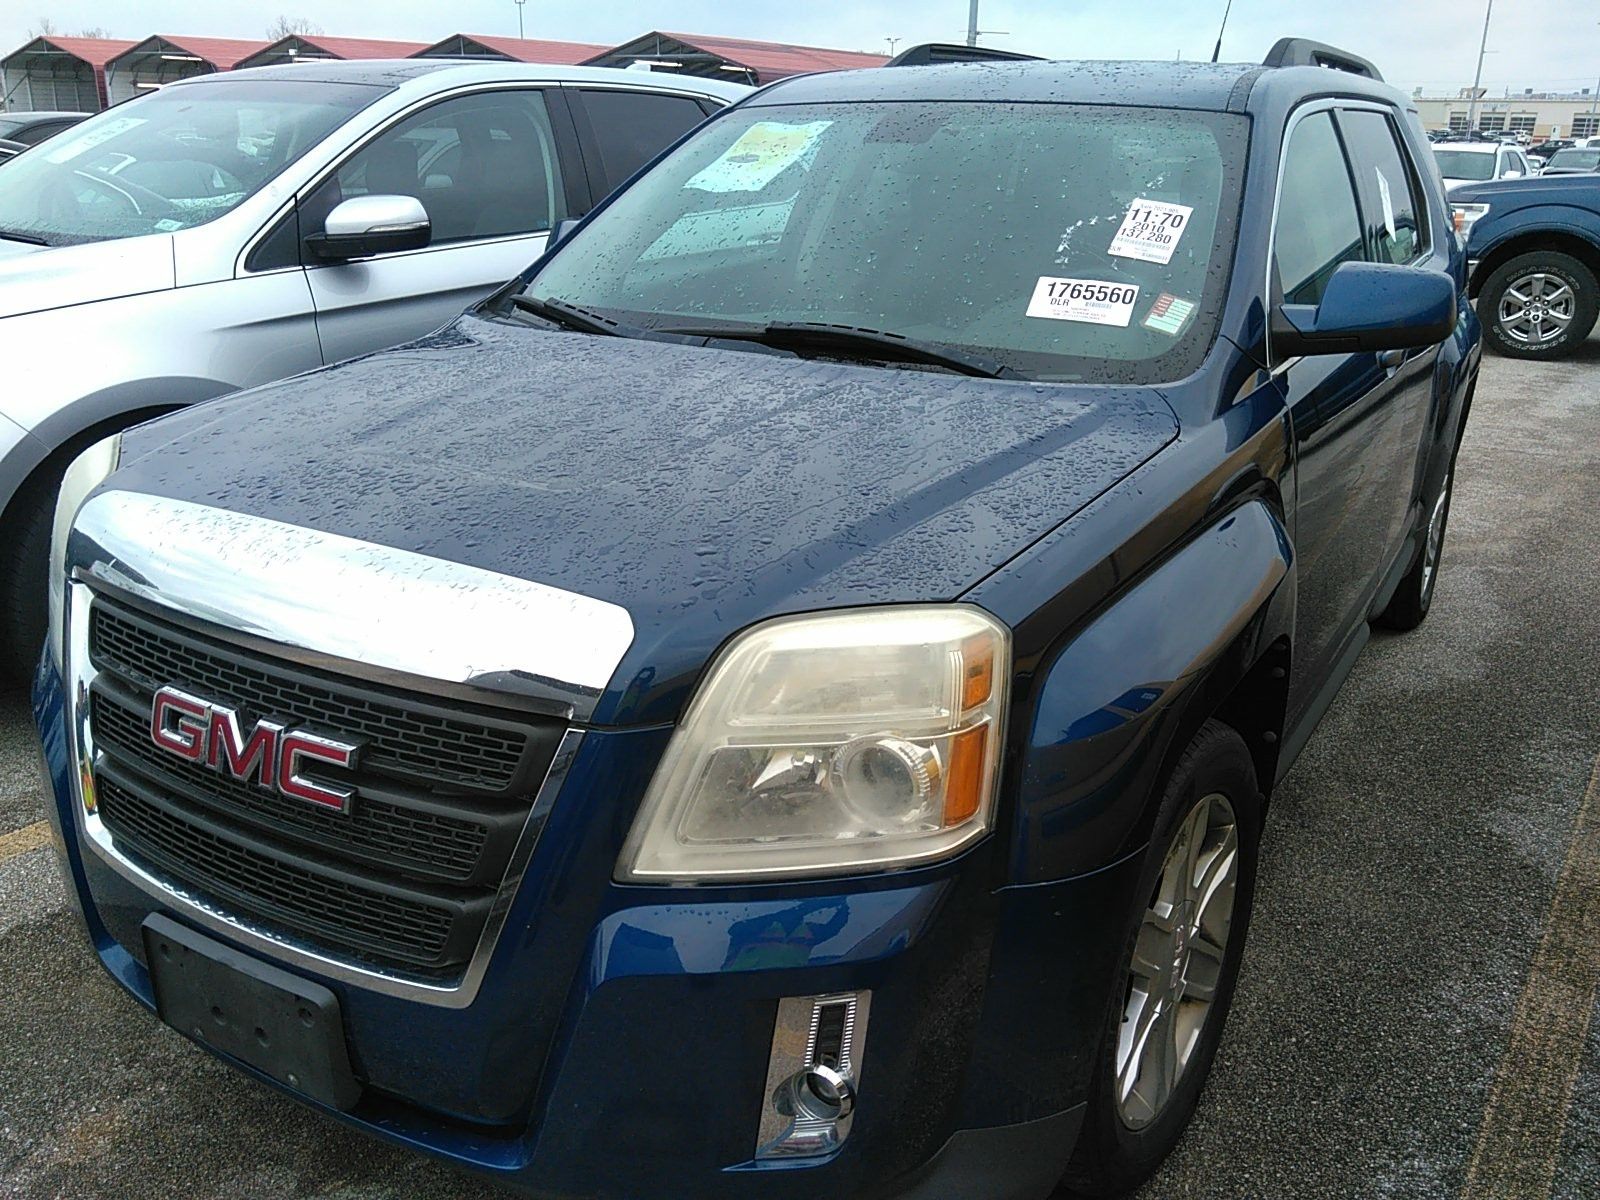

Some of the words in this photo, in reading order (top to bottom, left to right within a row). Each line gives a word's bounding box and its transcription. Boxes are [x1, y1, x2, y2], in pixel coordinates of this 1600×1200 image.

[1132, 208, 1184, 228] 11:70
[1133, 222, 1165, 233] 2010
[1047, 281, 1136, 305] 1765560
[1050, 298, 1070, 306] DLR
[151, 685, 358, 815] GMC
